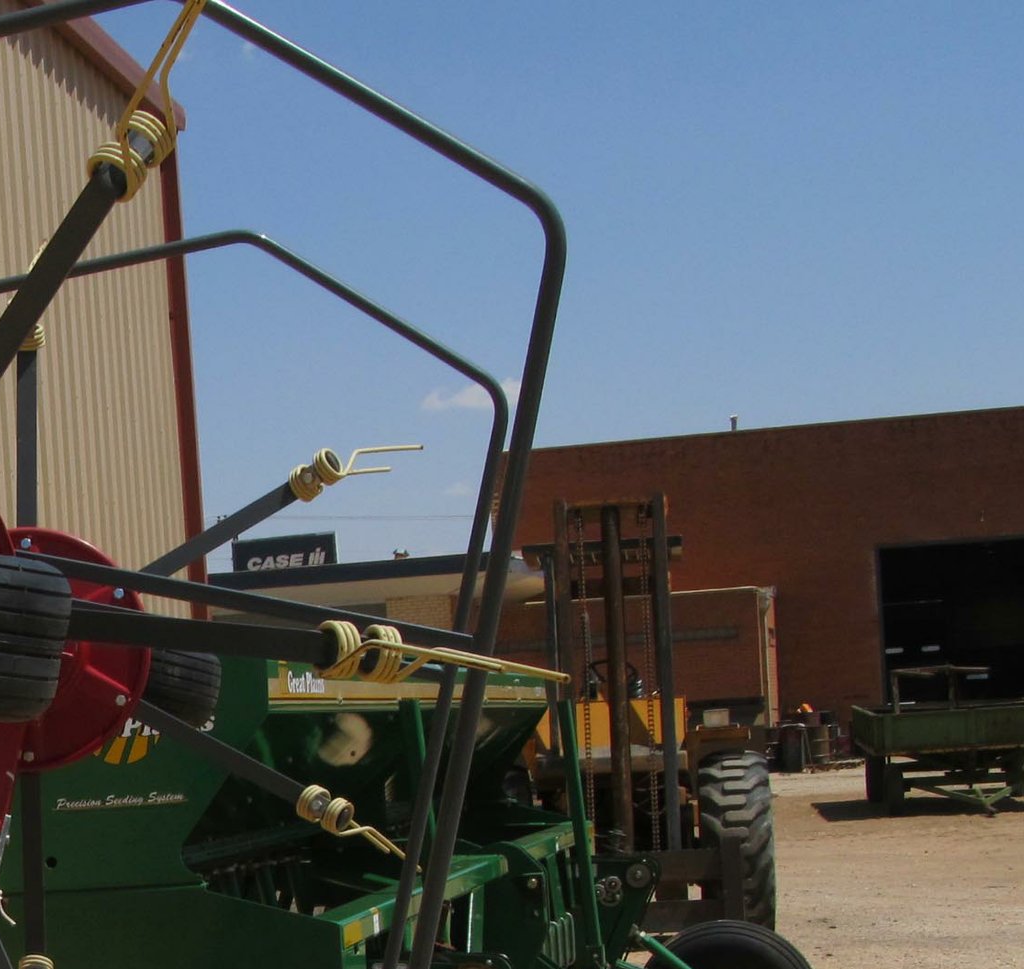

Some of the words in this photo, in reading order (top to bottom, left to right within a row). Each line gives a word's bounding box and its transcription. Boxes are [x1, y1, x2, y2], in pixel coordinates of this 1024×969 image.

[247, 552, 304, 571] CASE
[287, 670, 306, 694] Great
[56, 797, 102, 810] Precision
[105, 794, 144, 806] Seeding
[147, 791, 185, 804] System
